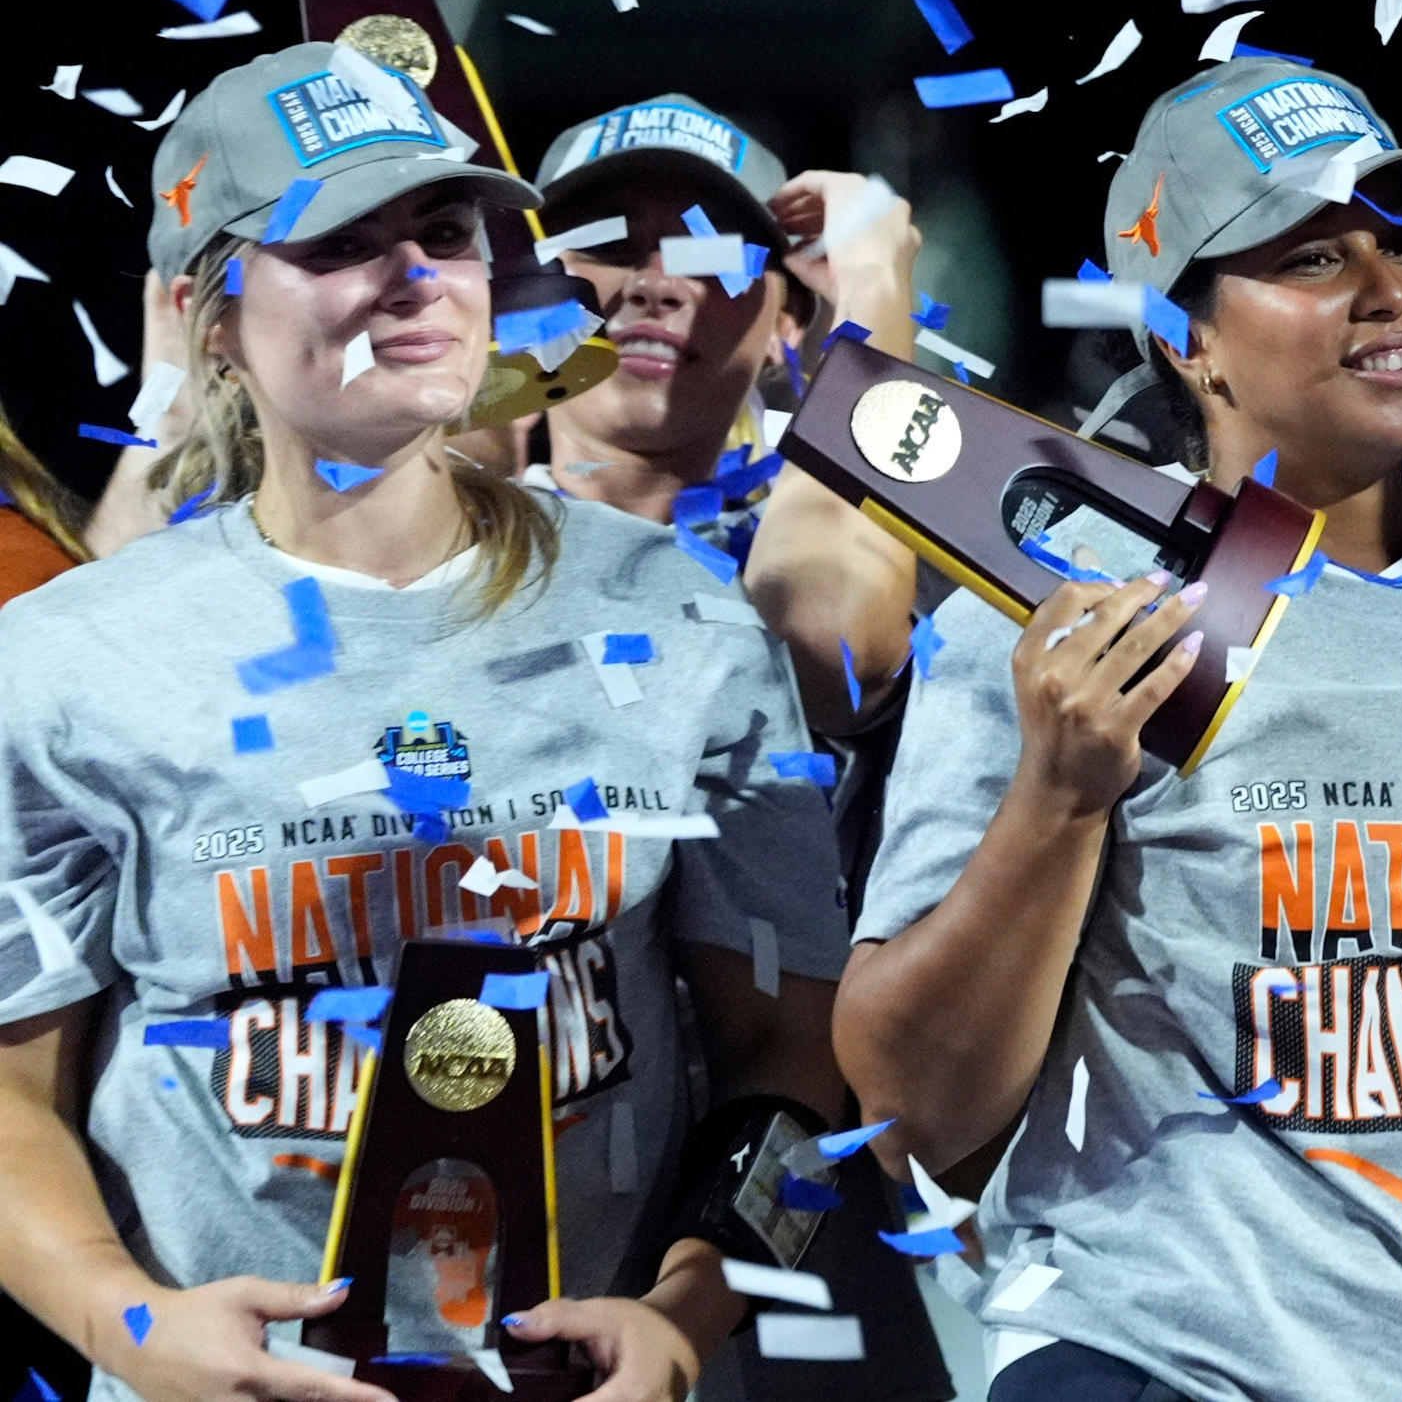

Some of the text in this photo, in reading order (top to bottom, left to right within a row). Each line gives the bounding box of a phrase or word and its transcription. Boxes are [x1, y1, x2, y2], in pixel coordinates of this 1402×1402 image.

[1254, 82, 1363, 120] NATIONAL
[296, 125, 324, 152] 2025
[628, 107, 732, 151] NATIONAL
[1251, 133, 1279, 159] 2025
[1272, 108, 1382, 146] CHAMPIONS
[889, 393, 947, 477] NCAA
[1011, 496, 1037, 534] 2025
[396, 748, 450, 766] COLLEGE
[424, 760, 469, 777] SERIES
[1231, 781, 1308, 812] 2025
[1323, 782, 1395, 807] NCAA
[192, 825, 265, 863] 2025
[281, 815, 359, 846] NCAA
[509, 798, 517, 820] I
